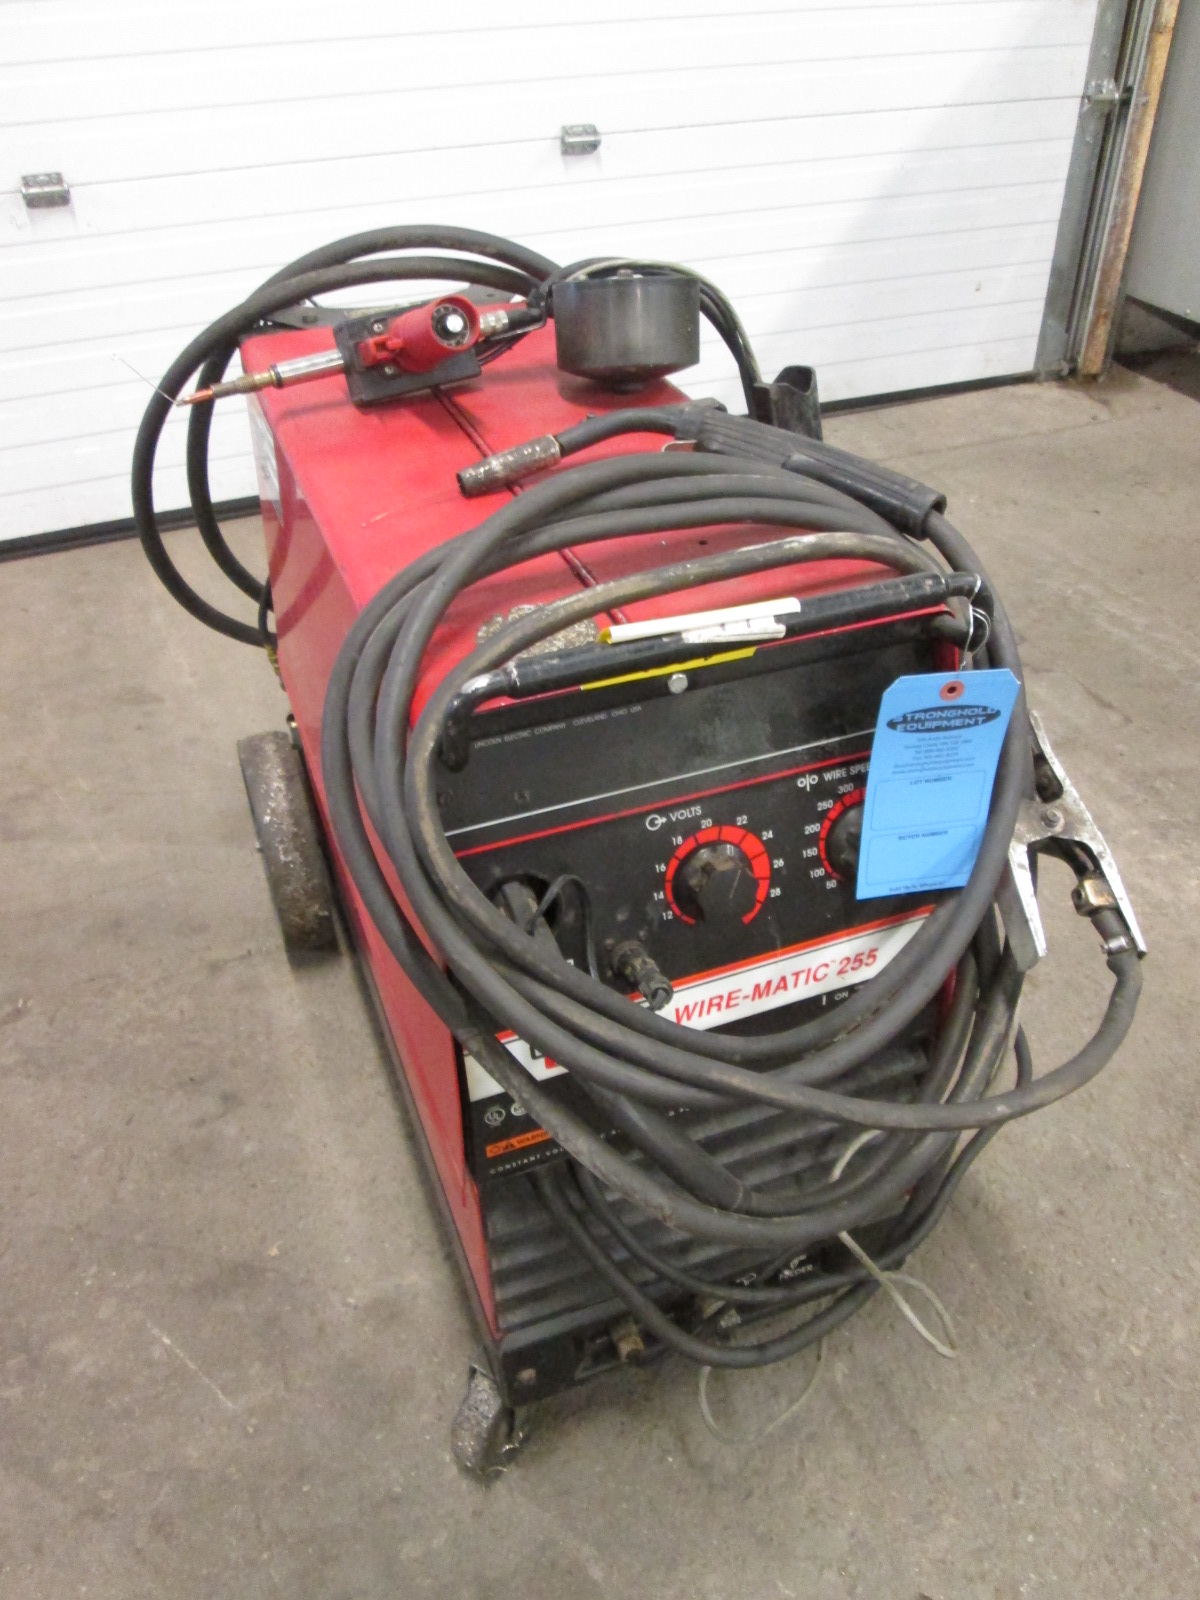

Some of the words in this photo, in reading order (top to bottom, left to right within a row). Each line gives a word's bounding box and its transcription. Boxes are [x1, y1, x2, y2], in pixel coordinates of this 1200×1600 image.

[893, 707, 997, 723] STRONGHOLD
[896, 716, 987, 732] EQUIPMENT
[823, 767, 848, 782] WIRE
[849, 762, 871, 776] SPEE
[837, 783, 854, 795] 300
[817, 800, 834, 812] 250
[670, 805, 702, 823] VOLTS
[701, 818, 713, 829] 20
[736, 815, 748, 826] 22
[762, 829, 774, 841] 24
[804, 823, 821, 835] 200
[672, 836, 683, 846] 18
[803, 847, 818, 859] 150
[655, 863, 667, 874] 16
[772, 858, 784, 870] 26
[810, 867, 825, 879] 100
[826, 879, 837, 890] 50
[653, 891, 665, 902] 14
[770, 887, 782, 898] 28
[662, 911, 674, 921] 12
[674, 962, 830, 1026] WIRE-MATIC
[836, 947, 879, 976] 255
[834, 990, 849, 1001] ON
